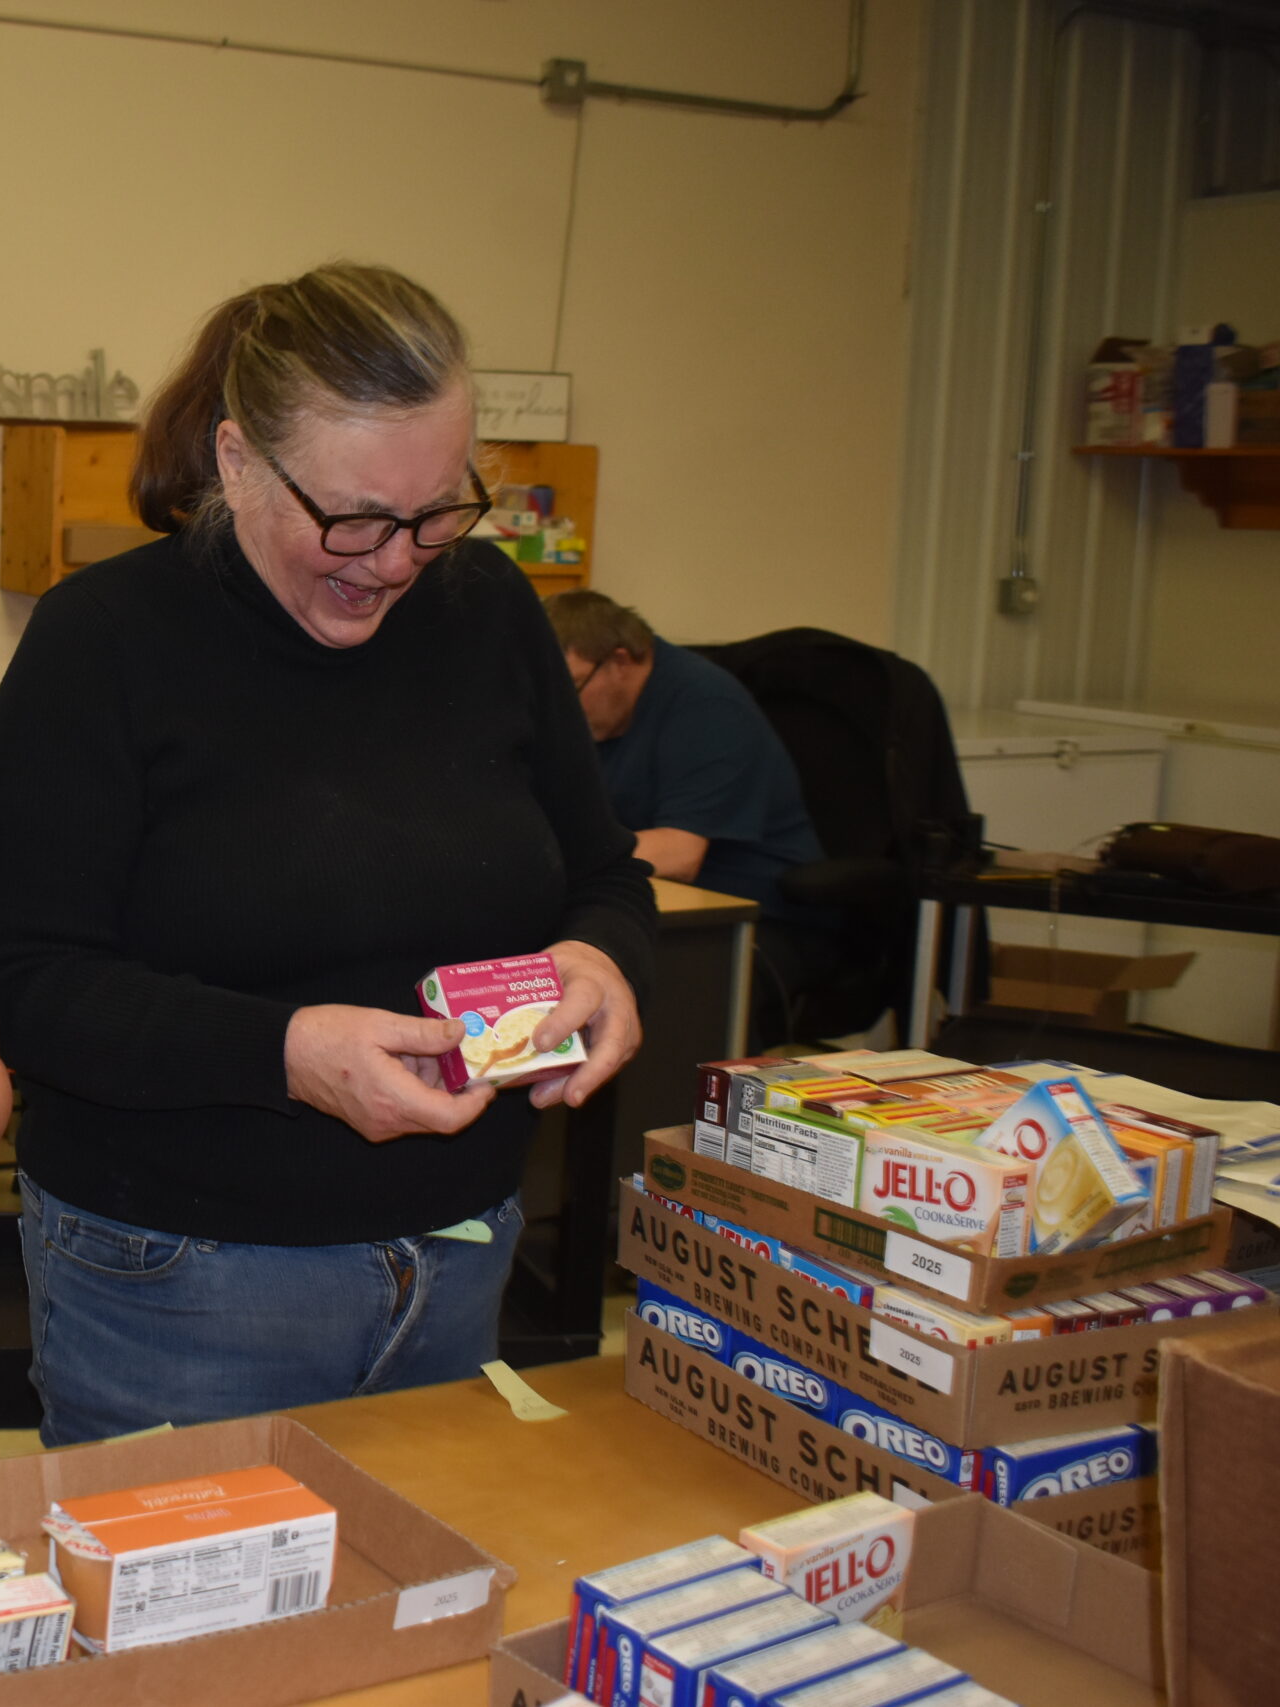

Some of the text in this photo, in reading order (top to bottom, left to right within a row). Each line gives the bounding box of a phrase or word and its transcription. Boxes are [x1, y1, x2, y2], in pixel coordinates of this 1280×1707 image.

[506, 994, 531, 1003] serve
[508, 976, 557, 992] tapioca
[536, 988, 560, 998] cook
[755, 1113, 818, 1139] Nutrition Facts
[885, 1145, 913, 1160] vanilla
[873, 1159, 976, 1212] JELL-O
[912, 1253, 942, 1276] 2025
[631, 1206, 939, 1395] AUGUST SCHE
[641, 1303, 720, 1349] OREO
[694, 1281, 762, 1336] BREWING
[771, 1323, 851, 1381] COMPANY
[899, 1346, 922, 1367] 2025
[997, 1352, 1130, 1397] AUGUST
[733, 1354, 825, 1405] OREO
[1047, 1383, 1125, 1411] BREWING
[639, 1336, 929, 1499] AUGUST SCH
[708, 1416, 846, 1502] BREWING COMP
[842, 1411, 947, 1470] OREO
[1021, 1446, 1134, 1500] OREO
[1057, 1506, 1136, 1541] UGUS
[804, 1546, 835, 1566] vanilla
[619, 1636, 633, 1696] OREO
